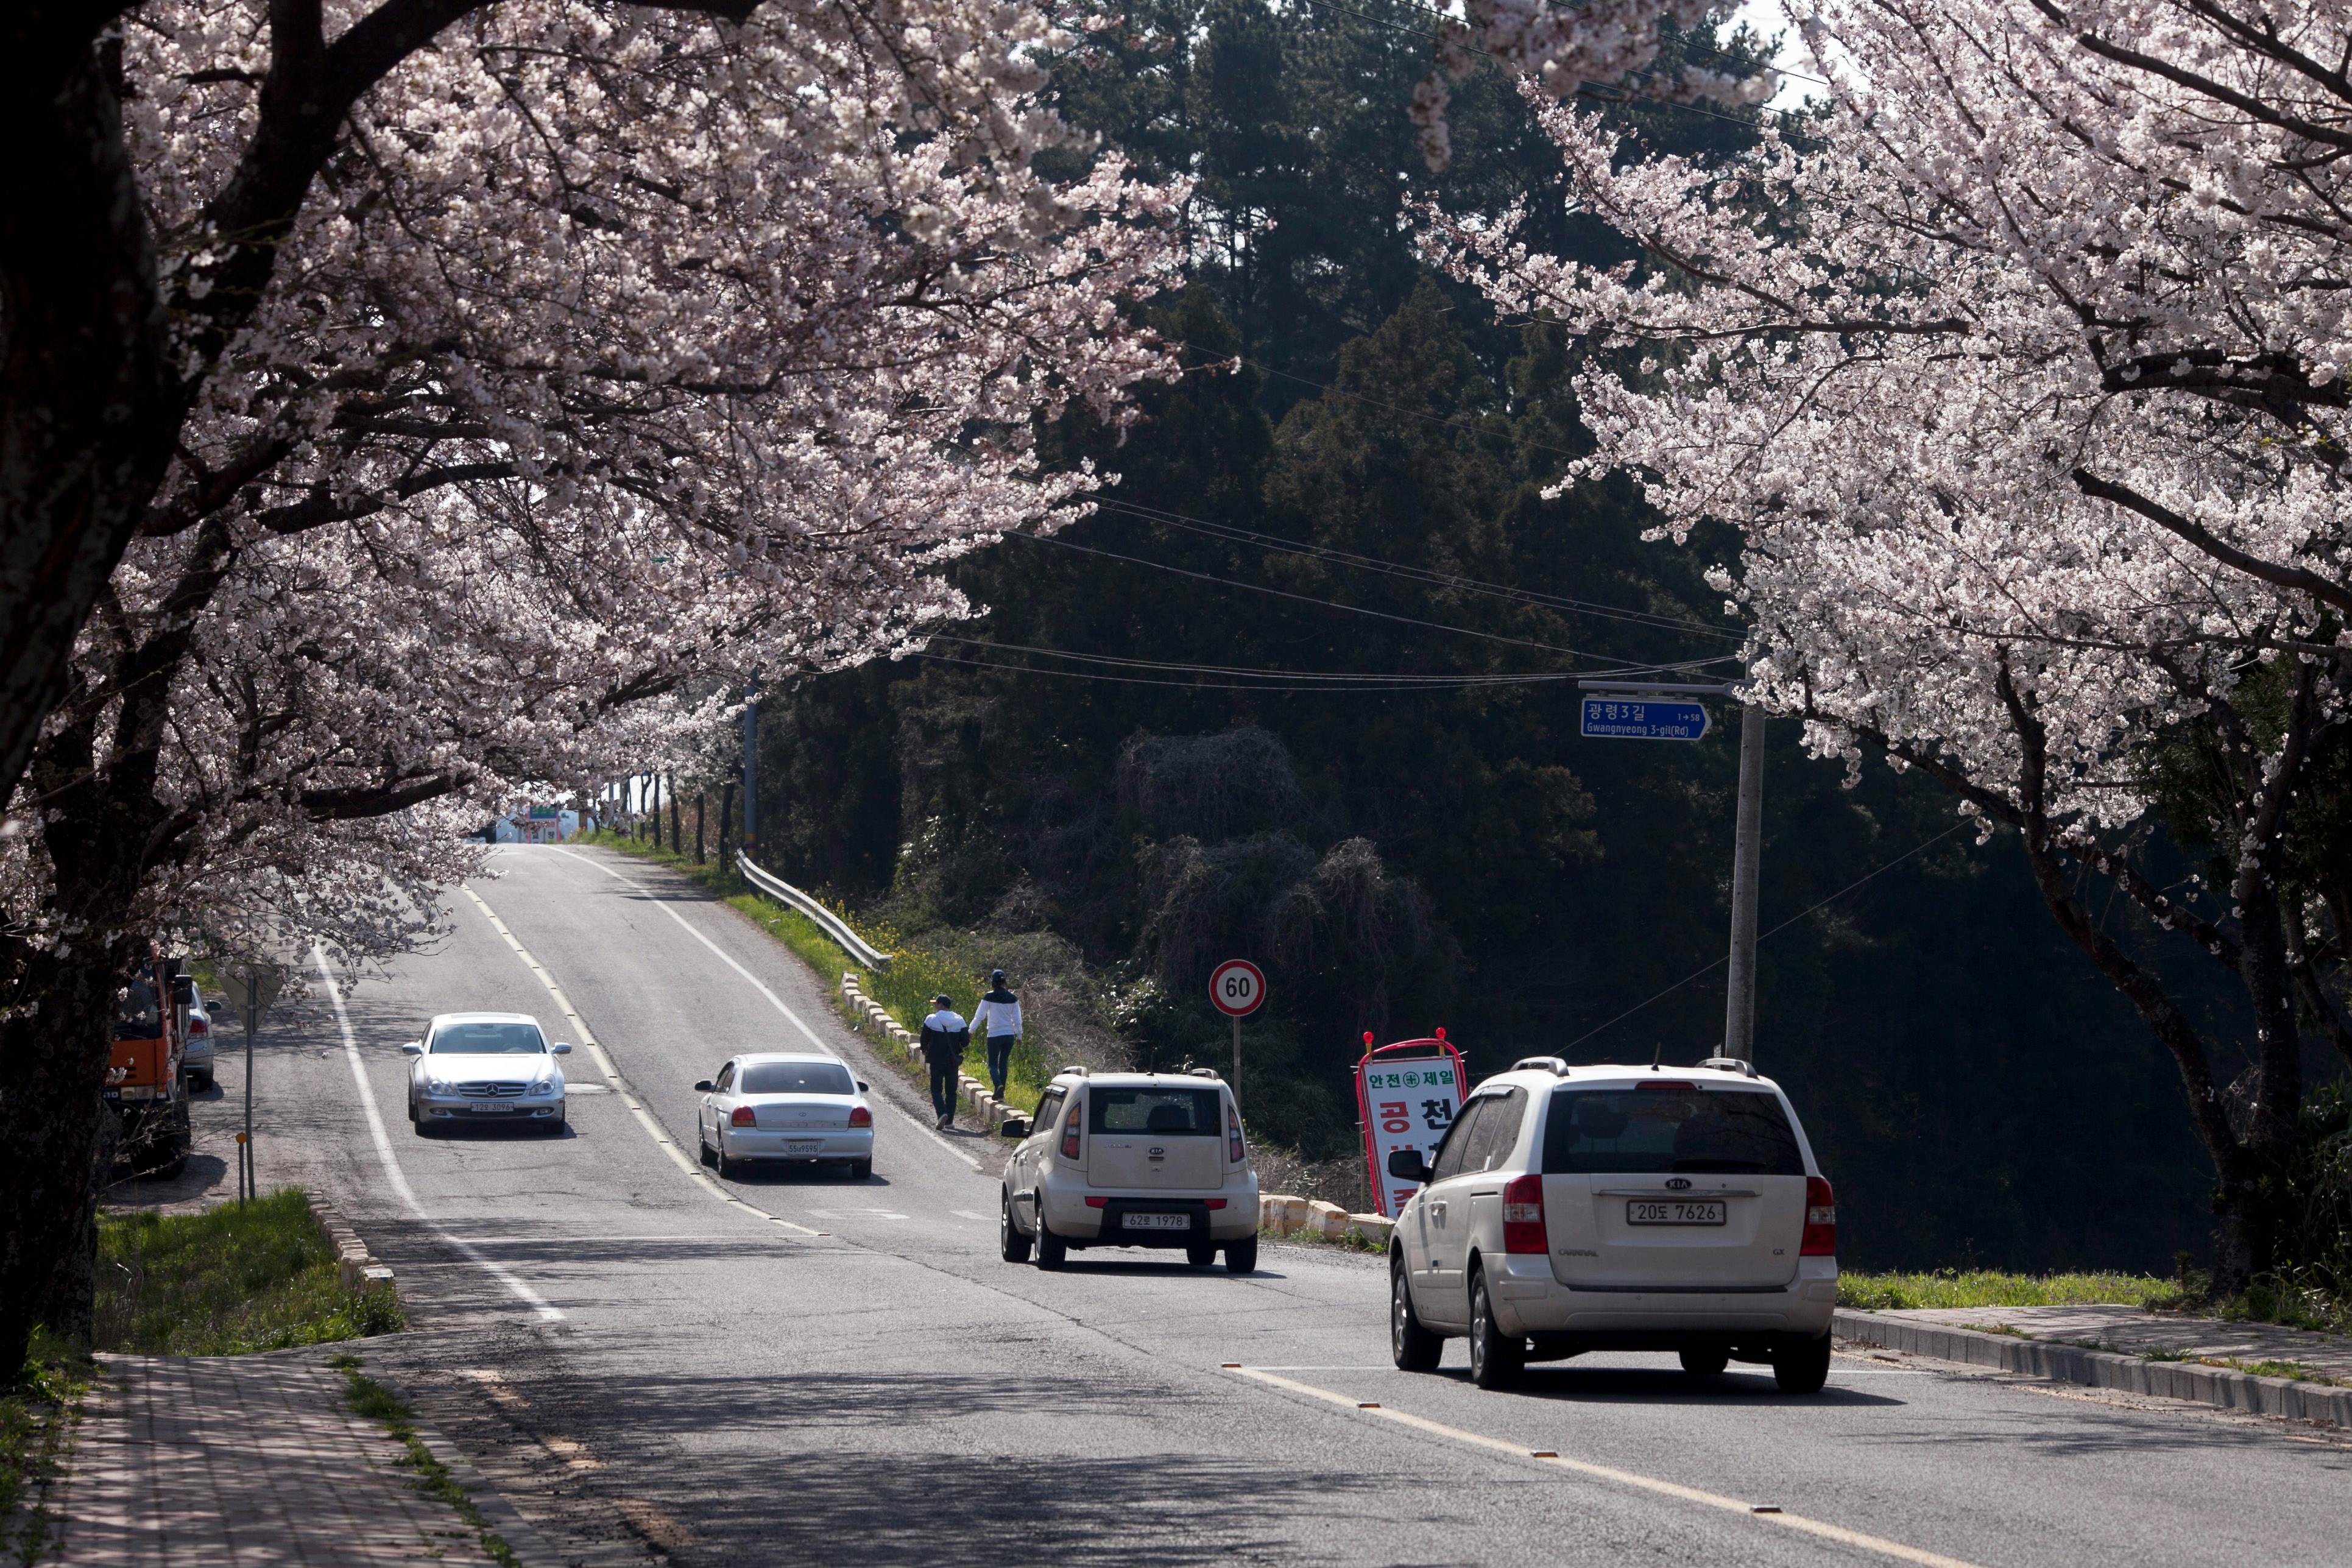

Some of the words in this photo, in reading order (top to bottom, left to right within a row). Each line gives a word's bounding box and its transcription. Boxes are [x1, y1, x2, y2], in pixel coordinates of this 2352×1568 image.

[1588, 704, 1644, 721] 광령3길
[1587, 722, 1647, 736] Gwangnyeong
[1651, 725, 1689, 737] 3-gil(Rd)
[1226, 977, 1250, 997] 60
[1369, 1073, 1401, 1089] 안전
[1422, 1070, 1455, 1086] 제일
[1669, 1180, 1687, 1188] KIA
[1637, 1204, 1668, 1220] 20도
[1675, 1204, 1716, 1220] 7626
[1129, 1215, 1150, 1226] 62로
[1156, 1215, 1183, 1226] 1978
